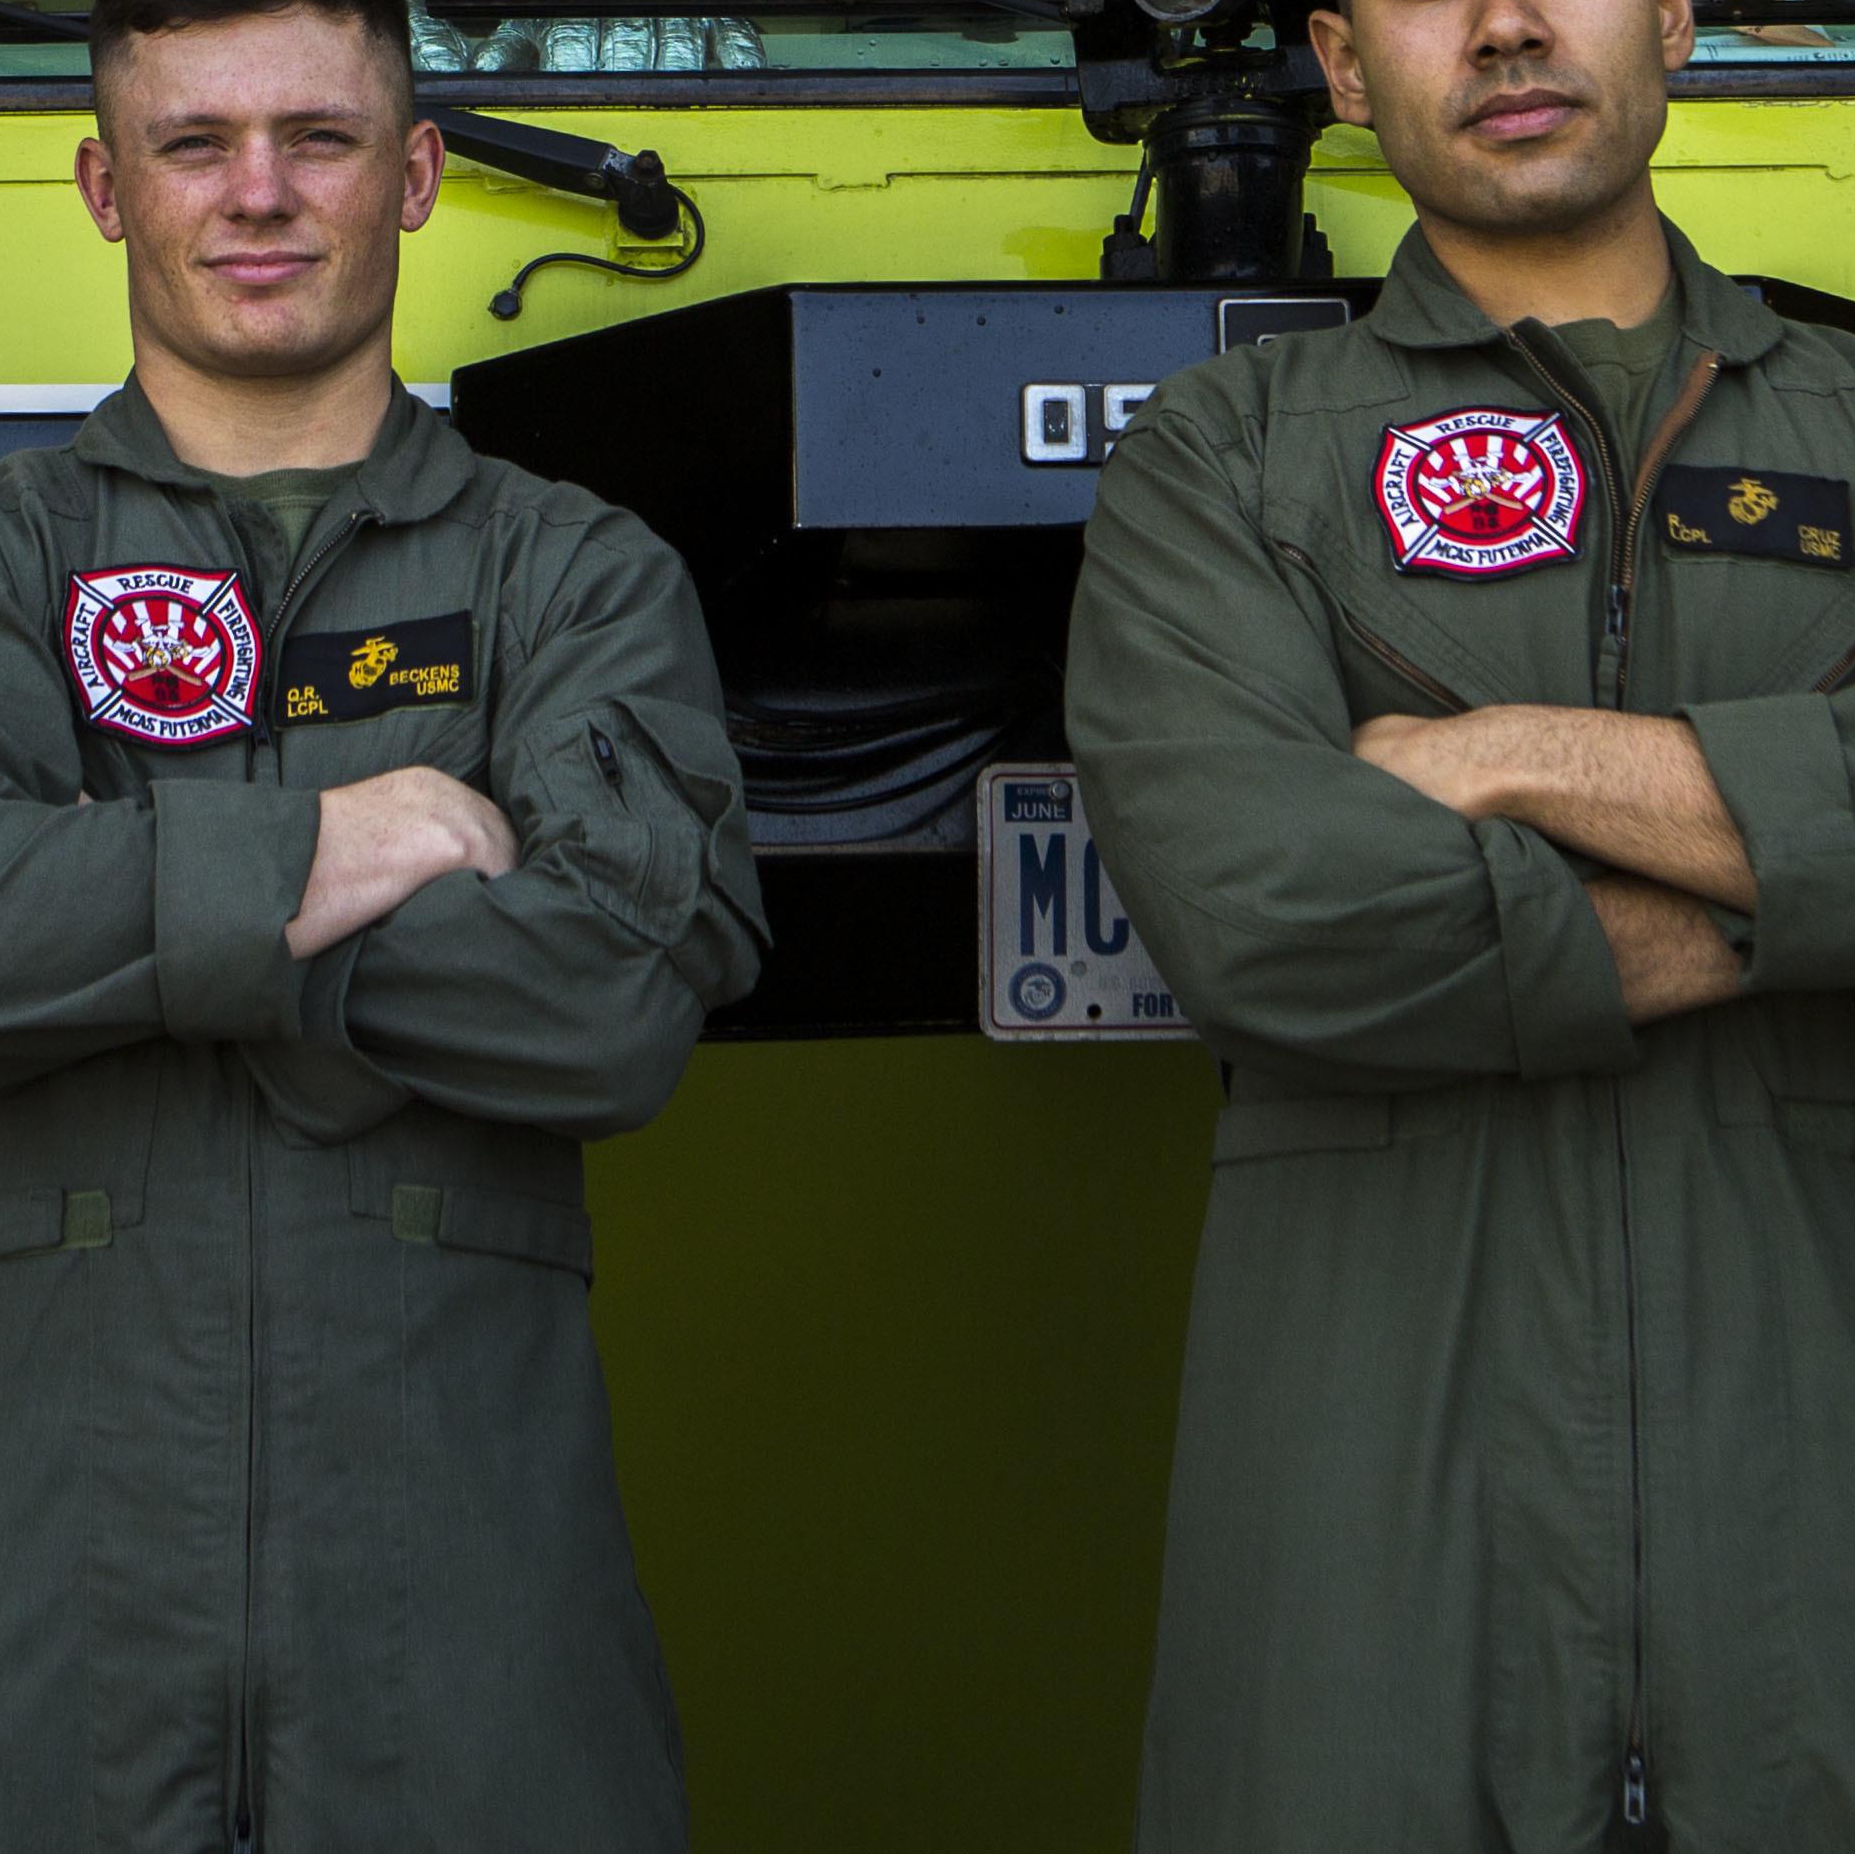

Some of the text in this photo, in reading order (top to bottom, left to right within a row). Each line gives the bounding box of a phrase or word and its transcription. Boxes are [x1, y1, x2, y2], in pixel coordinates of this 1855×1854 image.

[1436, 414, 1515, 434] RESCUE
[1386, 448, 1420, 528] AIRCRAFT
[1540, 431, 1575, 528] FIREFIGHTING
[1426, 532, 1550, 565] MCAS FUTENMA
[1669, 527, 1841, 561] LCPL USMC
[1798, 525, 1841, 546] CRUZ
[117, 574, 194, 594] RESCUE
[73, 603, 105, 689] AIRCRAFT
[217, 599, 253, 702] FIREFIGHTING
[389, 664, 460, 686] BECKENS
[287, 679, 459, 718] LCPL USMC
[109, 704, 229, 737] MCAS FUTENMA
[1011, 802, 1066, 819] JUNE
[1132, 993, 1173, 1018] FOR
